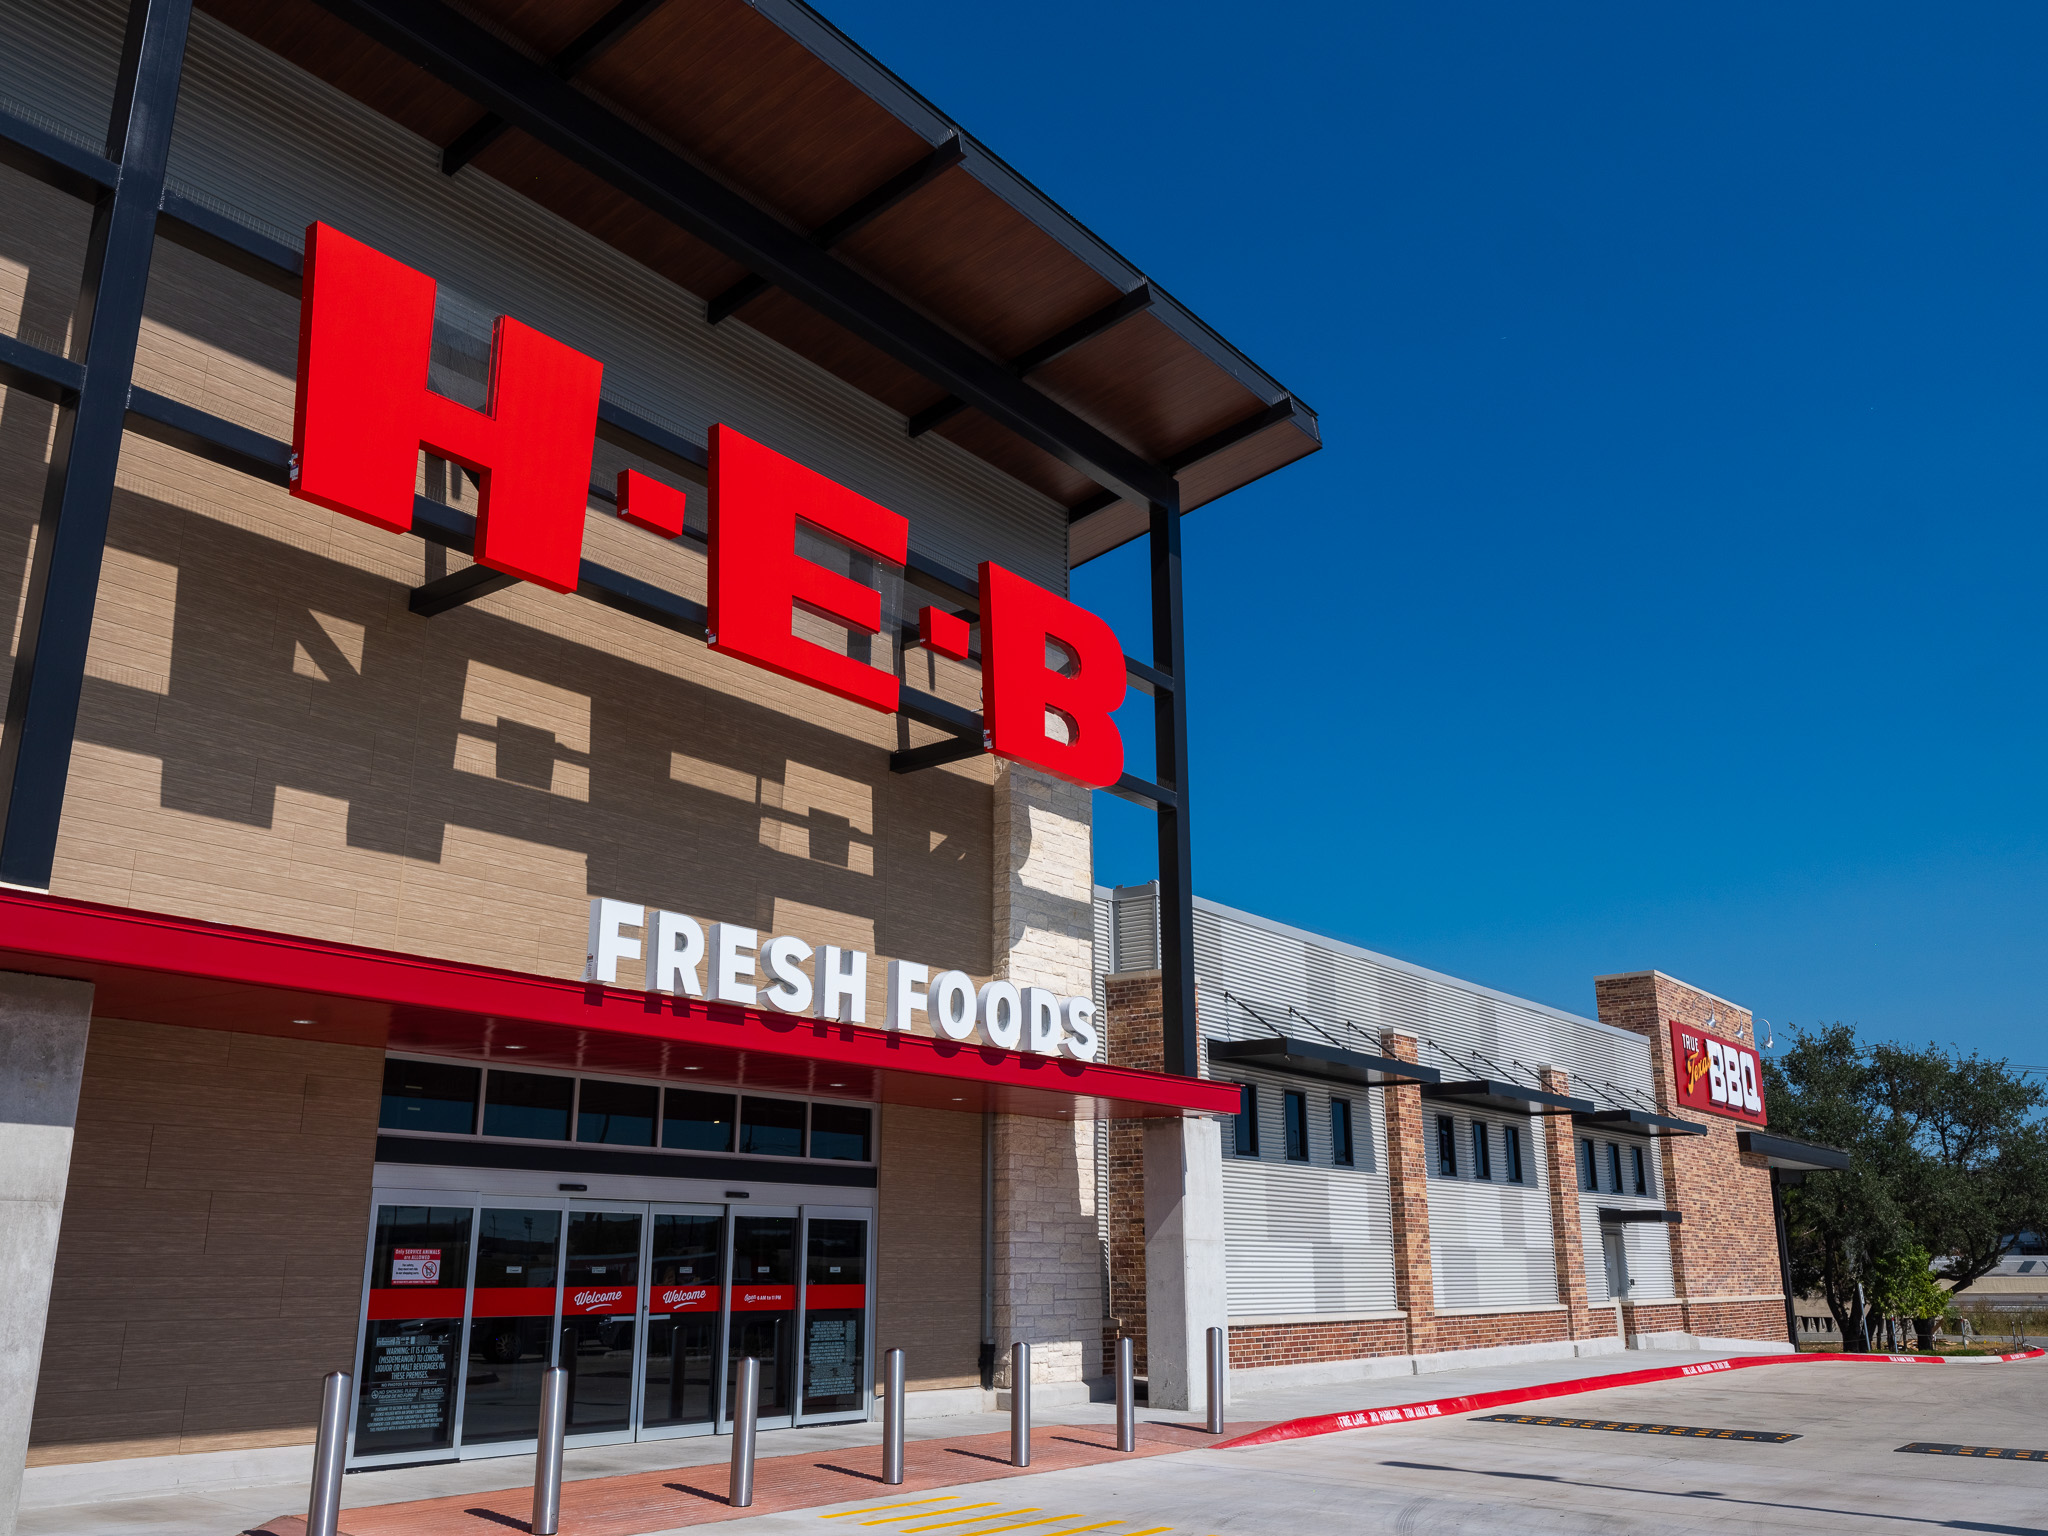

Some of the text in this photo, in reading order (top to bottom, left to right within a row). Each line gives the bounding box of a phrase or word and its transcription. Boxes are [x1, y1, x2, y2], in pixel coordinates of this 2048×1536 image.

[289, 221, 1127, 790] H-E-B
[587, 897, 1098, 1060] FRESH FOODS
[1681, 1033, 1699, 1052] TRUE
[1687, 1051, 1712, 1095] Texas
[1705, 1039, 1761, 1112] BBQ
[574, 1290, 622, 1306] Welcome
[662, 1289, 706, 1304] Welcome
[386, 1347, 410, 1355] WARNING:
[417, 1354, 423, 1362] TO
[375, 1364, 392, 1372] LIQUOR
[400, 1363, 413, 1371] MALT
[413, 1362, 438, 1370] BEVERAGES
[392, 1372, 405, 1380] THESE
